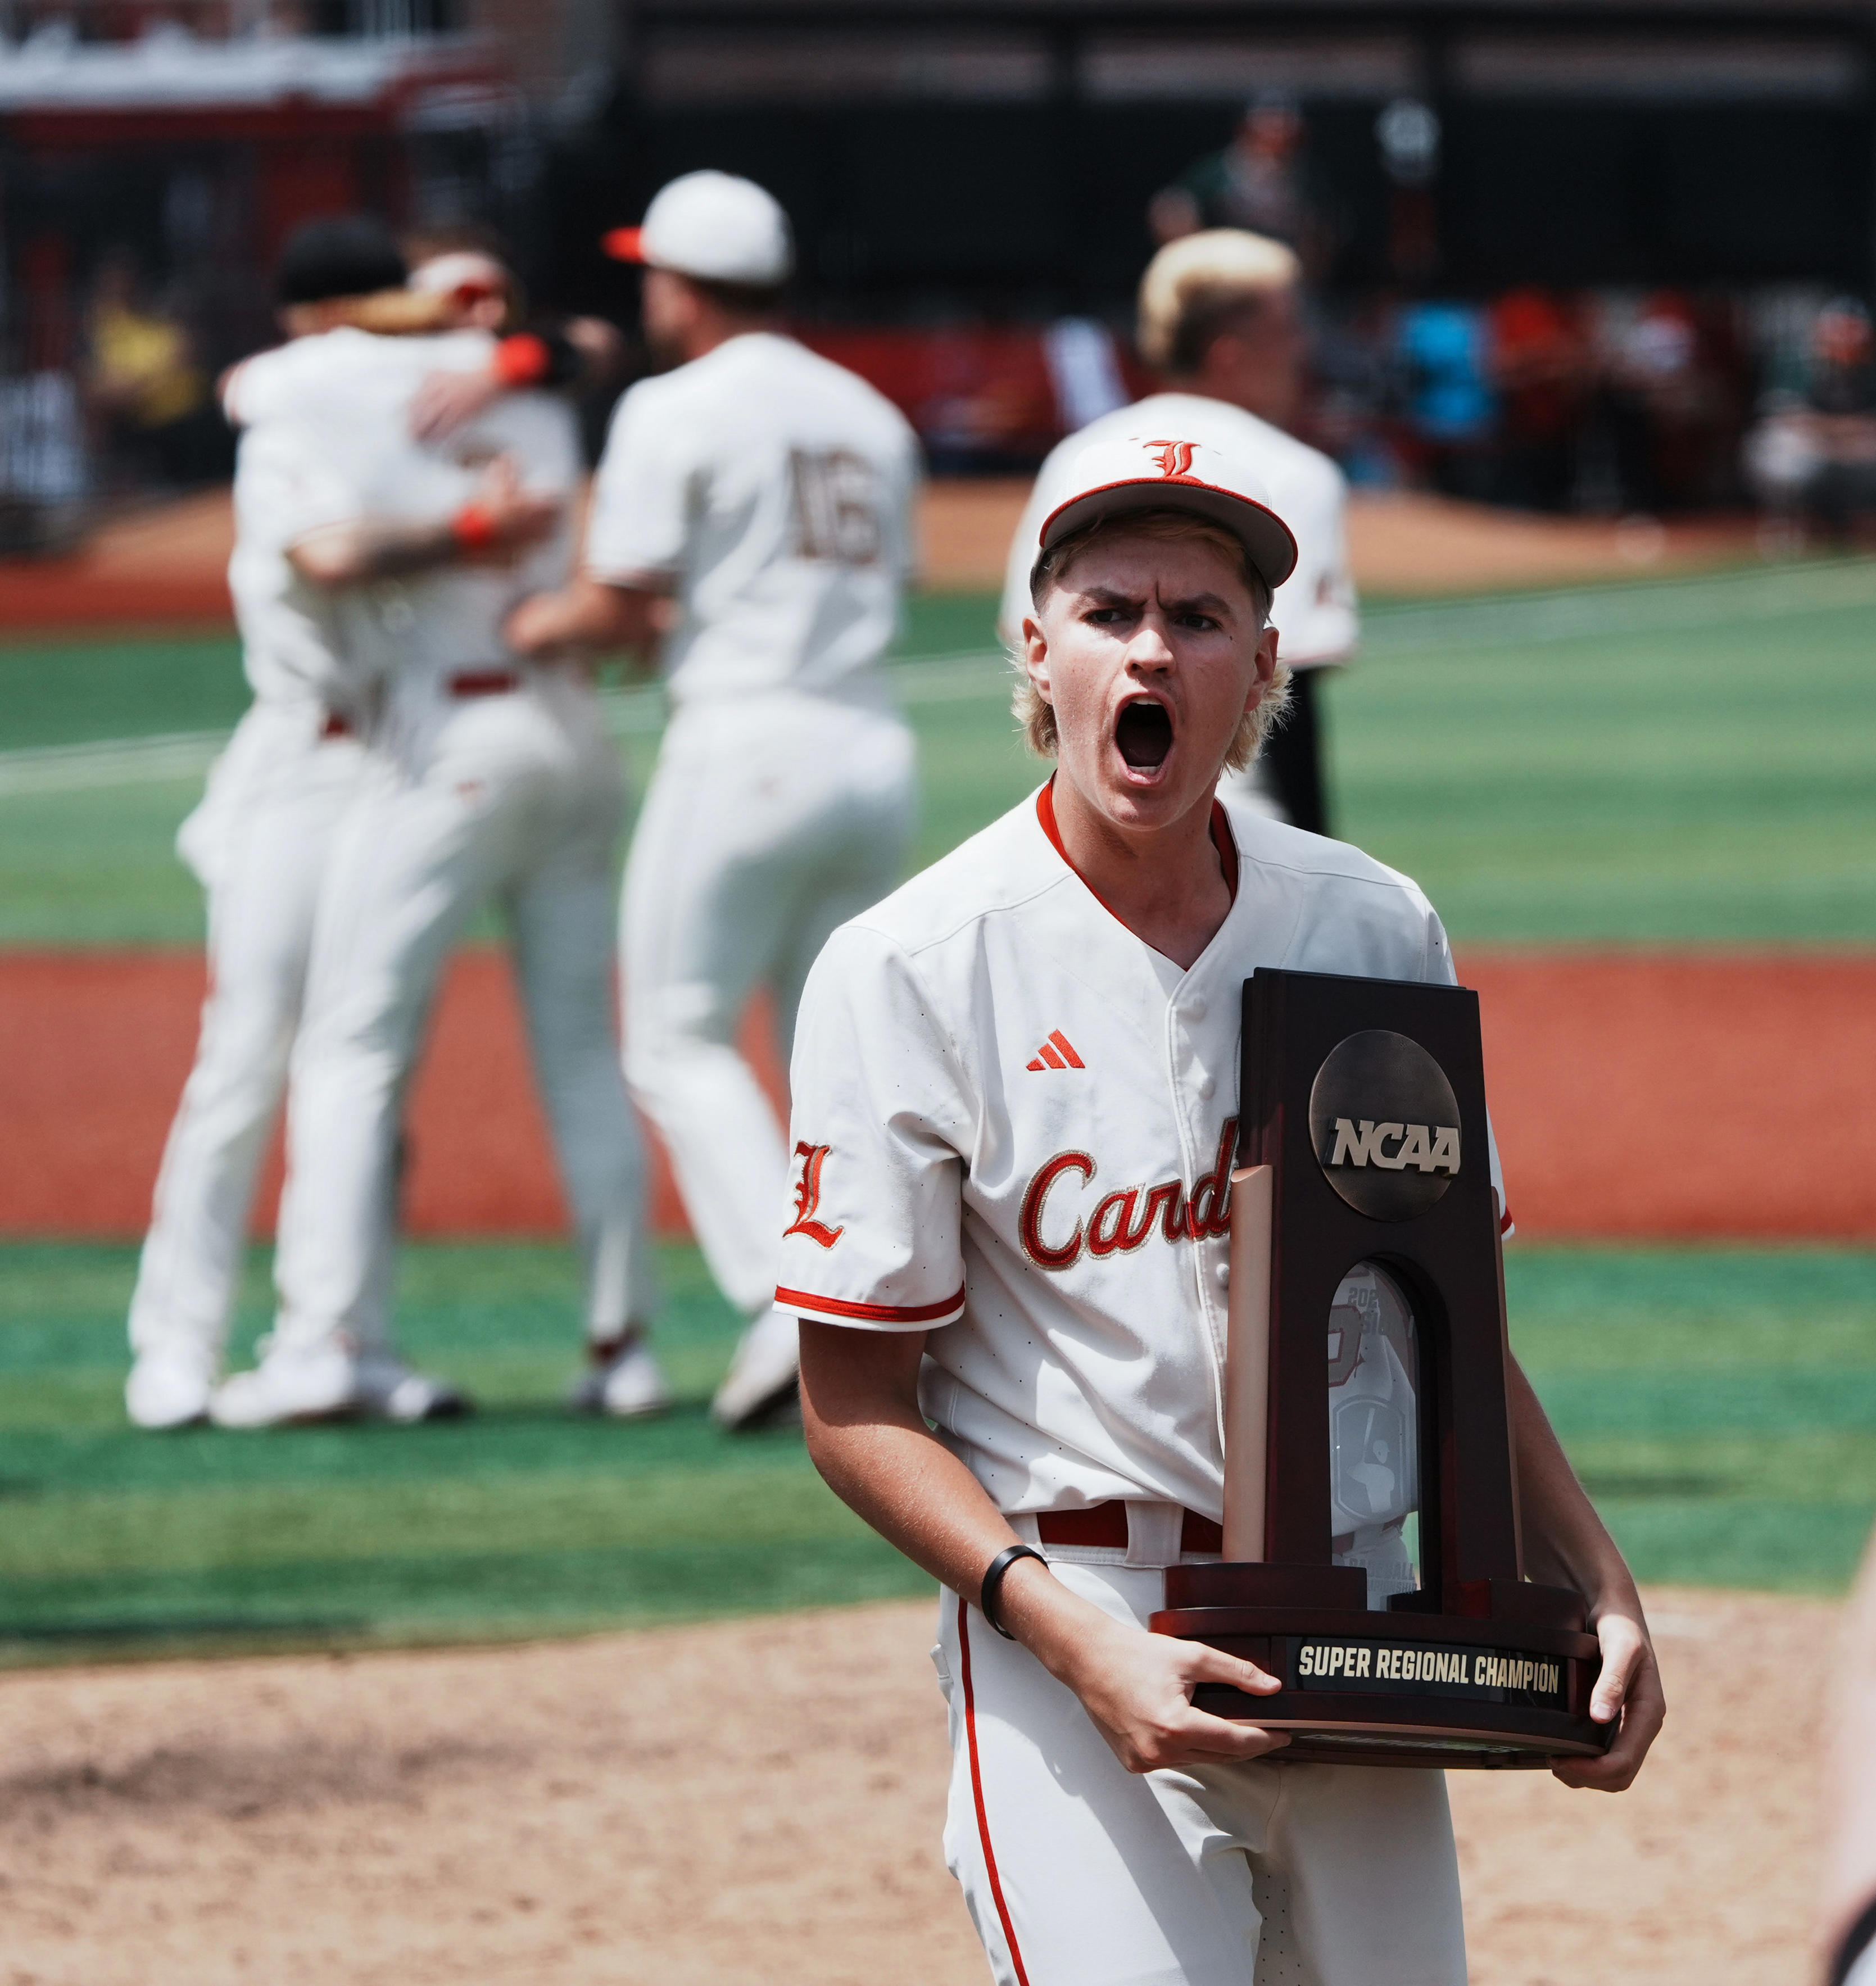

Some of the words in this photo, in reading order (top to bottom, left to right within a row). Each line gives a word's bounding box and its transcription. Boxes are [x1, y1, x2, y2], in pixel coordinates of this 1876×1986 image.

[1142, 440, 1202, 484] L
[1327, 1117, 1461, 1175] NCAA
[783, 1140, 845, 1251] L
[1298, 1645, 1371, 1678] SUPER
[1376, 1649, 1469, 1684] REGIONAL
[1474, 1656, 1559, 1694] CHAMPION
